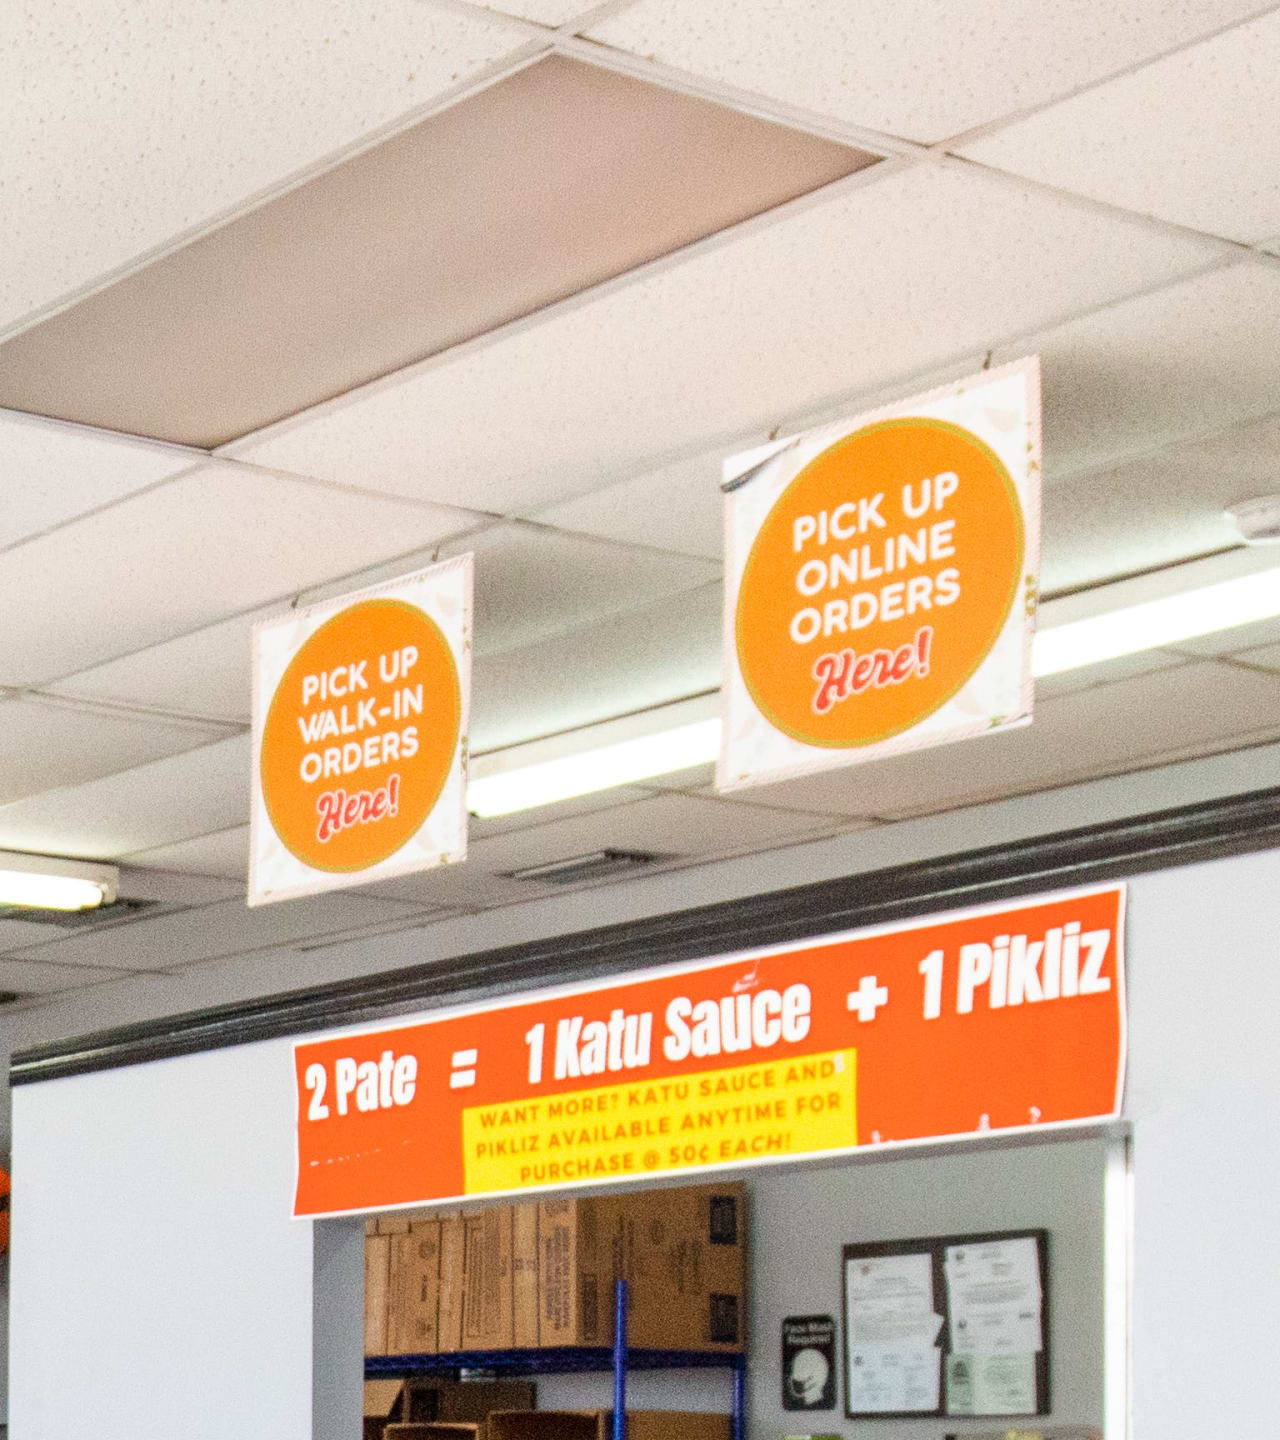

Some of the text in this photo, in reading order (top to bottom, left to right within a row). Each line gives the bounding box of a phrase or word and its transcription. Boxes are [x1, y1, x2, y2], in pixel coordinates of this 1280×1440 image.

[792, 470, 959, 552] PICK UP
[795, 519, 956, 598] ONLINE
[789, 567, 961, 645] ORDERS
[302, 645, 419, 706] PICK UP
[811, 625, 934, 716] Here!
[298, 684, 424, 744] WALK-IN
[299, 726, 420, 783] ORDERS
[317, 774, 401, 842] Here!
[305, 1062, 329, 1121] 2
[334, 1050, 418, 1116] Pate
[525, 1023, 546, 1084] 1
[554, 1009, 653, 1080] Katu
[663, 983, 811, 1062] Sauce
[846, 975, 889, 1022] +
[918, 949, 944, 1019] 1
[956, 921, 1111, 1014] Pikliz
[476, 1091, 841, 1159] PIKLIZ AVAILABLE ANYTIME FOR
[480, 1057, 835, 1129] WANT MORE? KATU SAUCE AND
[520, 1133, 792, 1182] PURCHASE @ 50¢ EACH!
